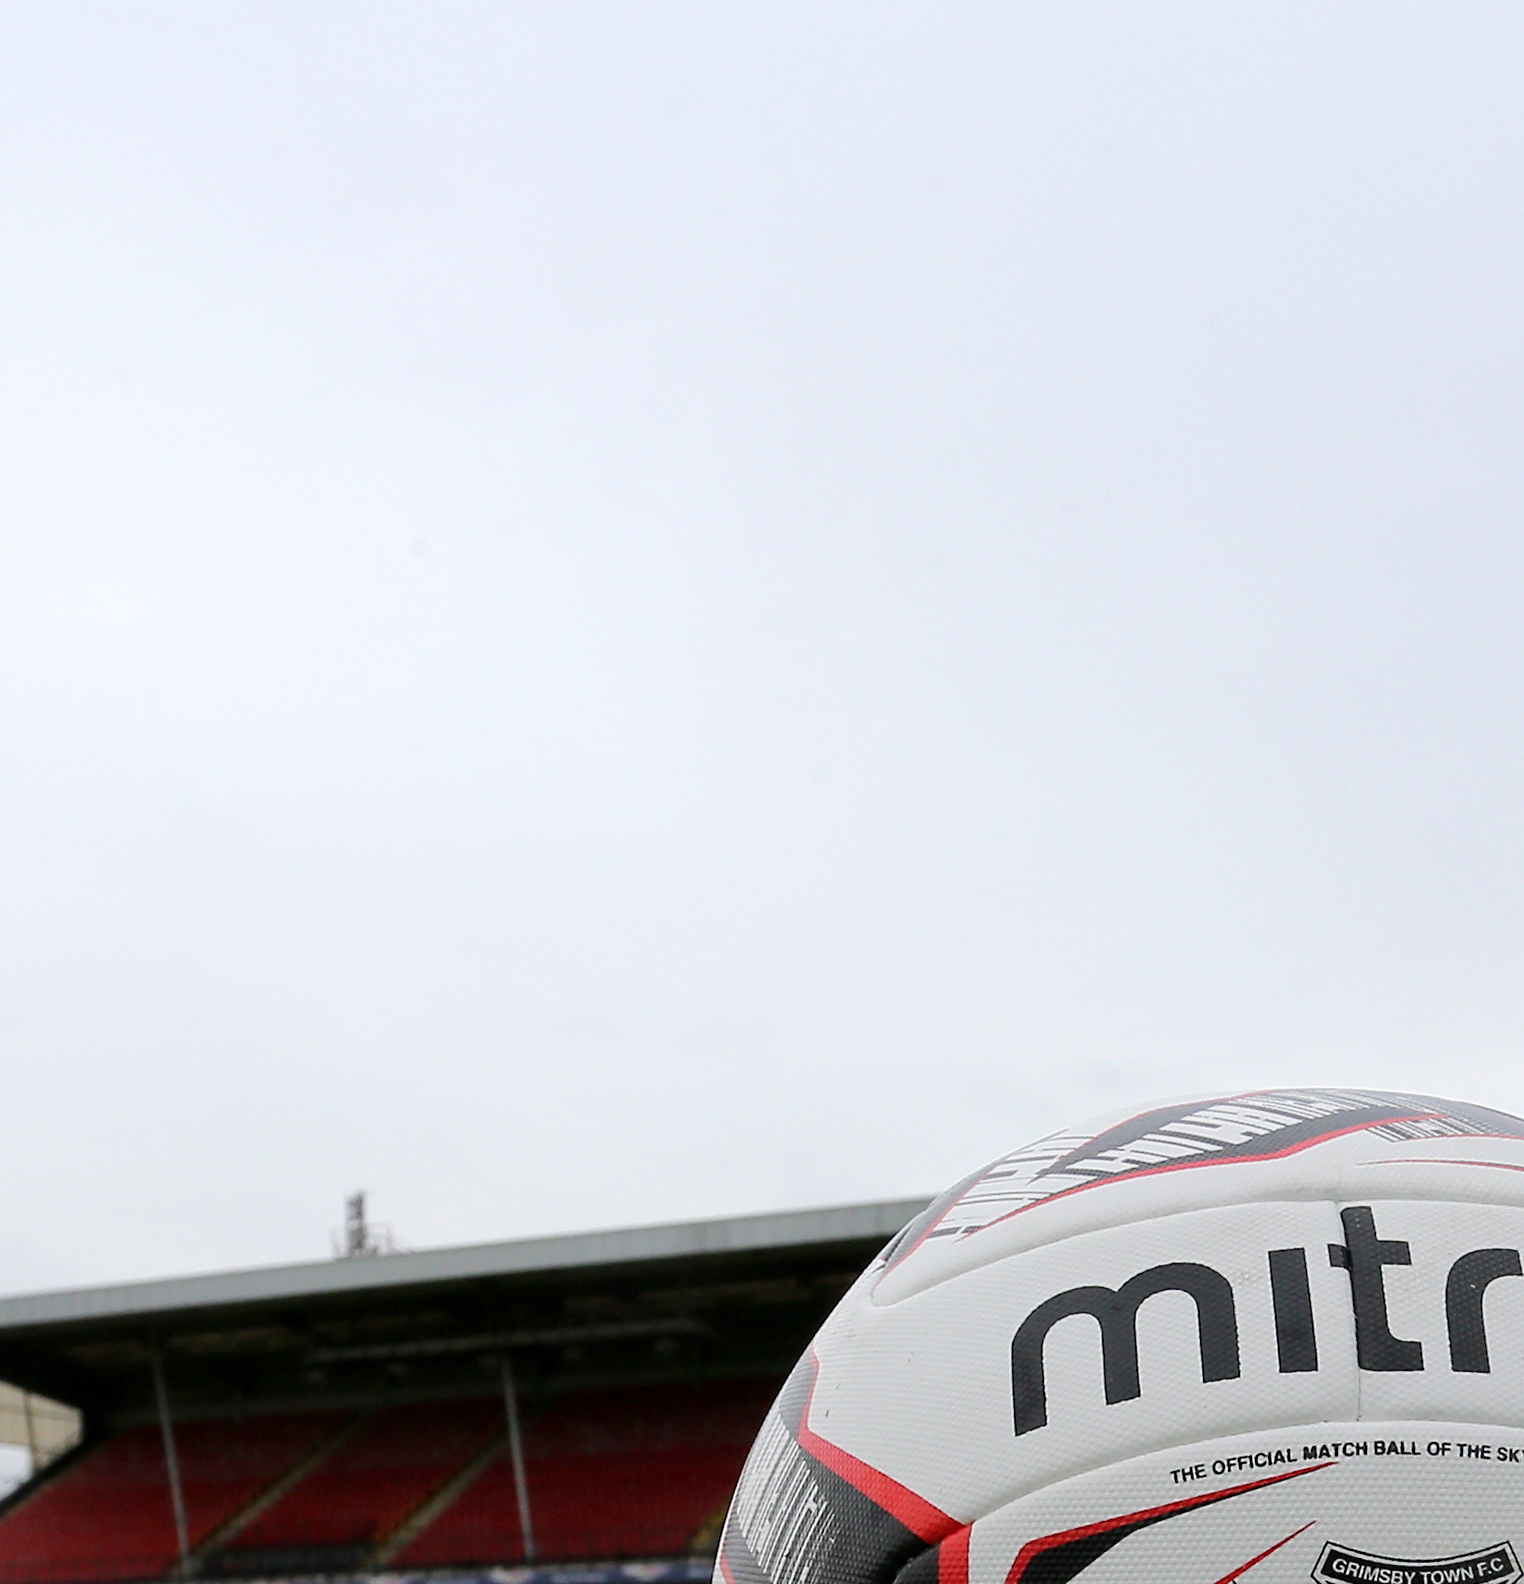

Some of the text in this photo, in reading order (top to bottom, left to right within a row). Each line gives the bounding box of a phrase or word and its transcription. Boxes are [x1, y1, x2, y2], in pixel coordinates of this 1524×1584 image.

[1170, 1463, 1207, 1484] THE
[1212, 1448, 1297, 1476] OFFICIAL
[1303, 1441, 1368, 1460] MATCH
[1374, 1440, 1421, 1456] BALL
[1426, 1441, 1451, 1456] OF
[1456, 1443, 1491, 1460] THE
